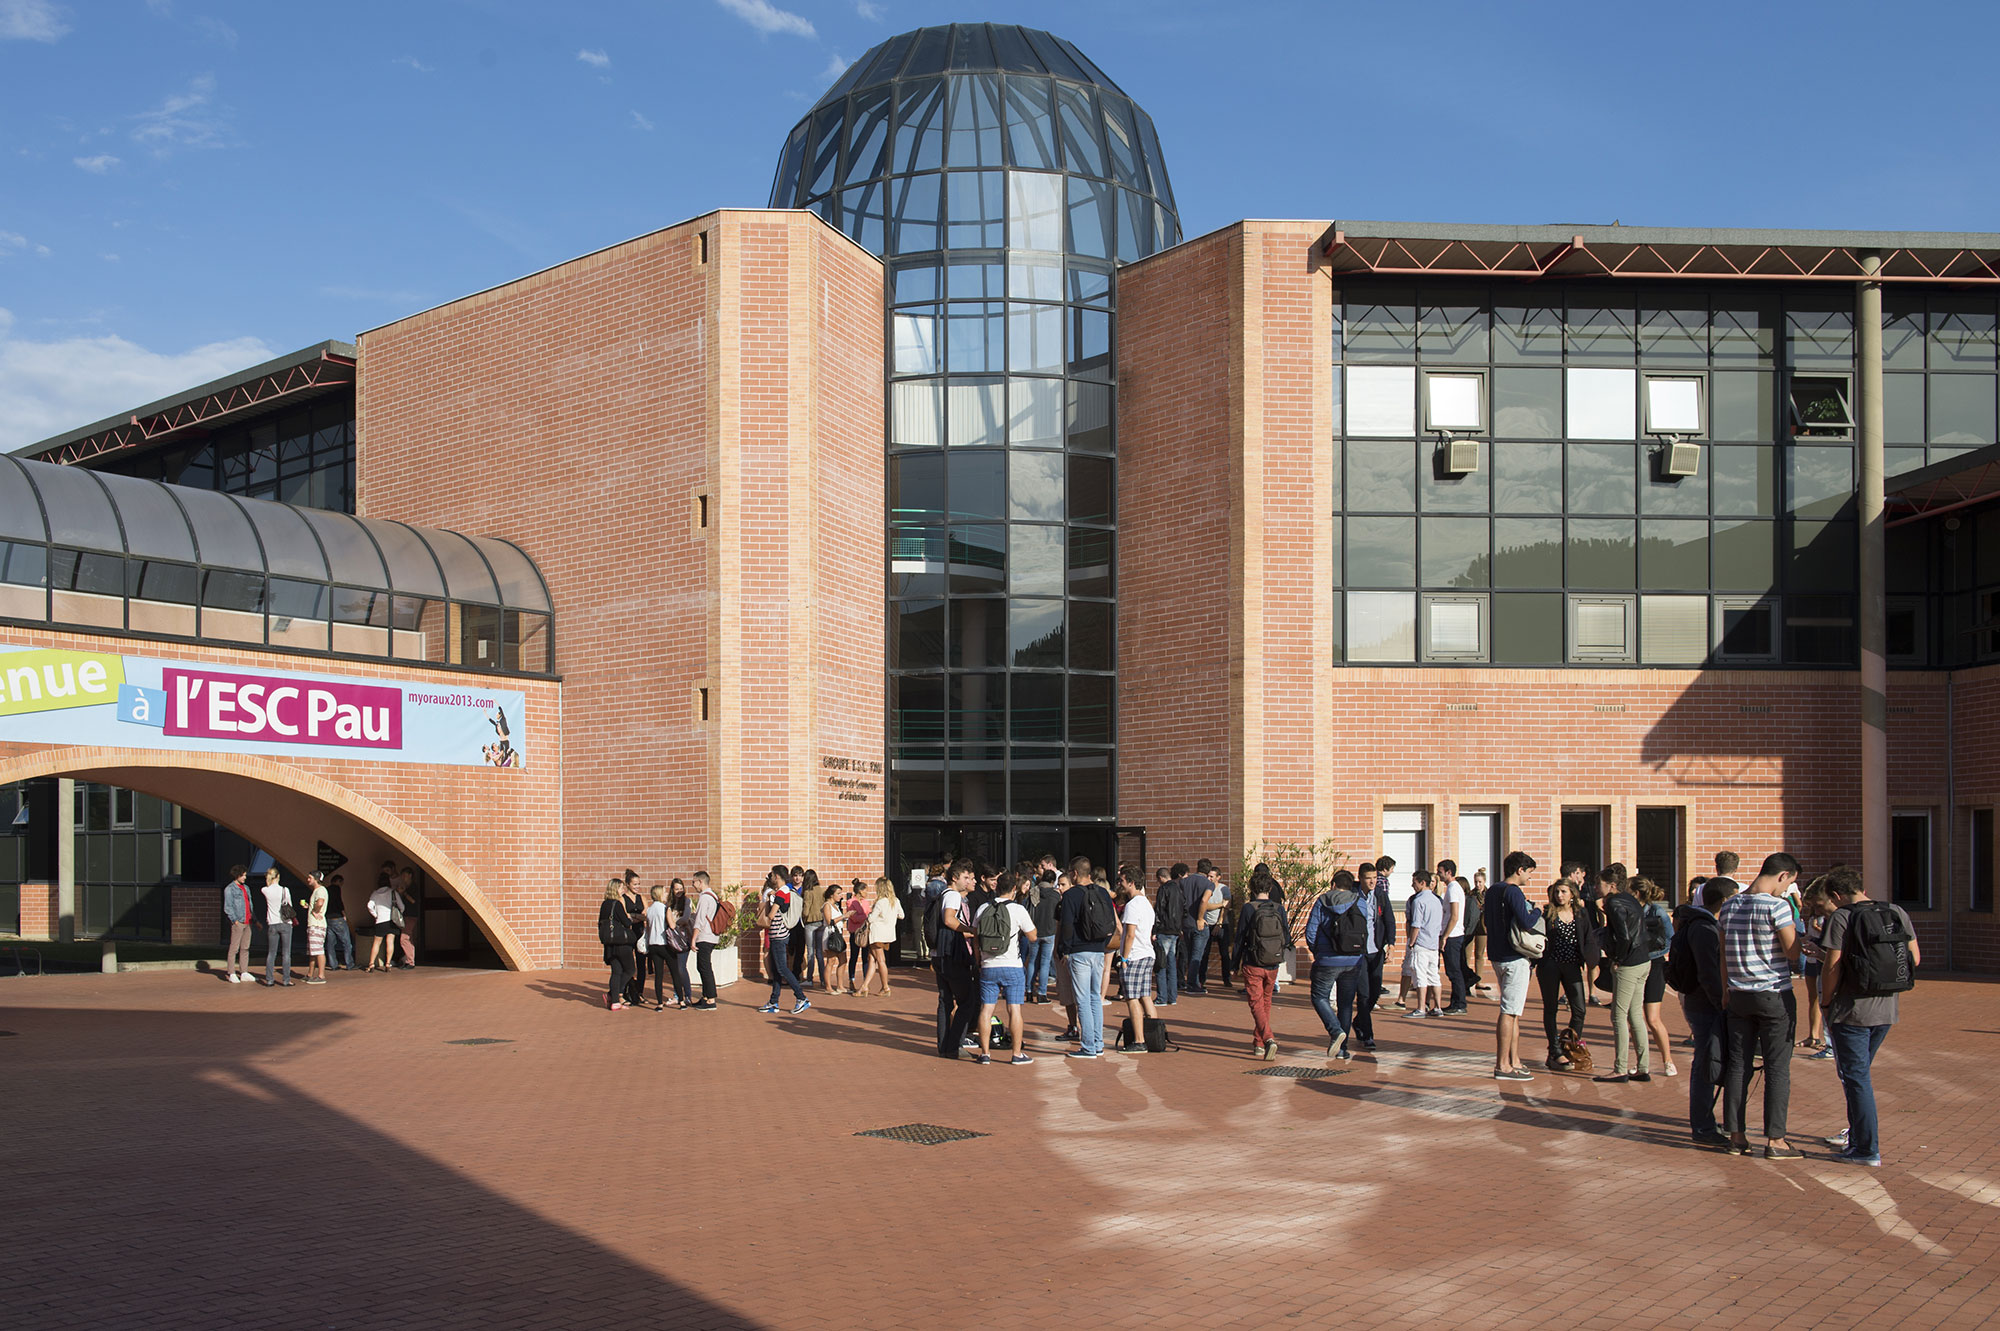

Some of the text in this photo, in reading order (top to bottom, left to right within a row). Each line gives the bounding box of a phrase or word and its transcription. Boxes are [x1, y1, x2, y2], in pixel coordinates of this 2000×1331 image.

[0, 660, 390, 741] nue à l'ESC Pau
[408, 693, 494, 708] myoraux2013.com
